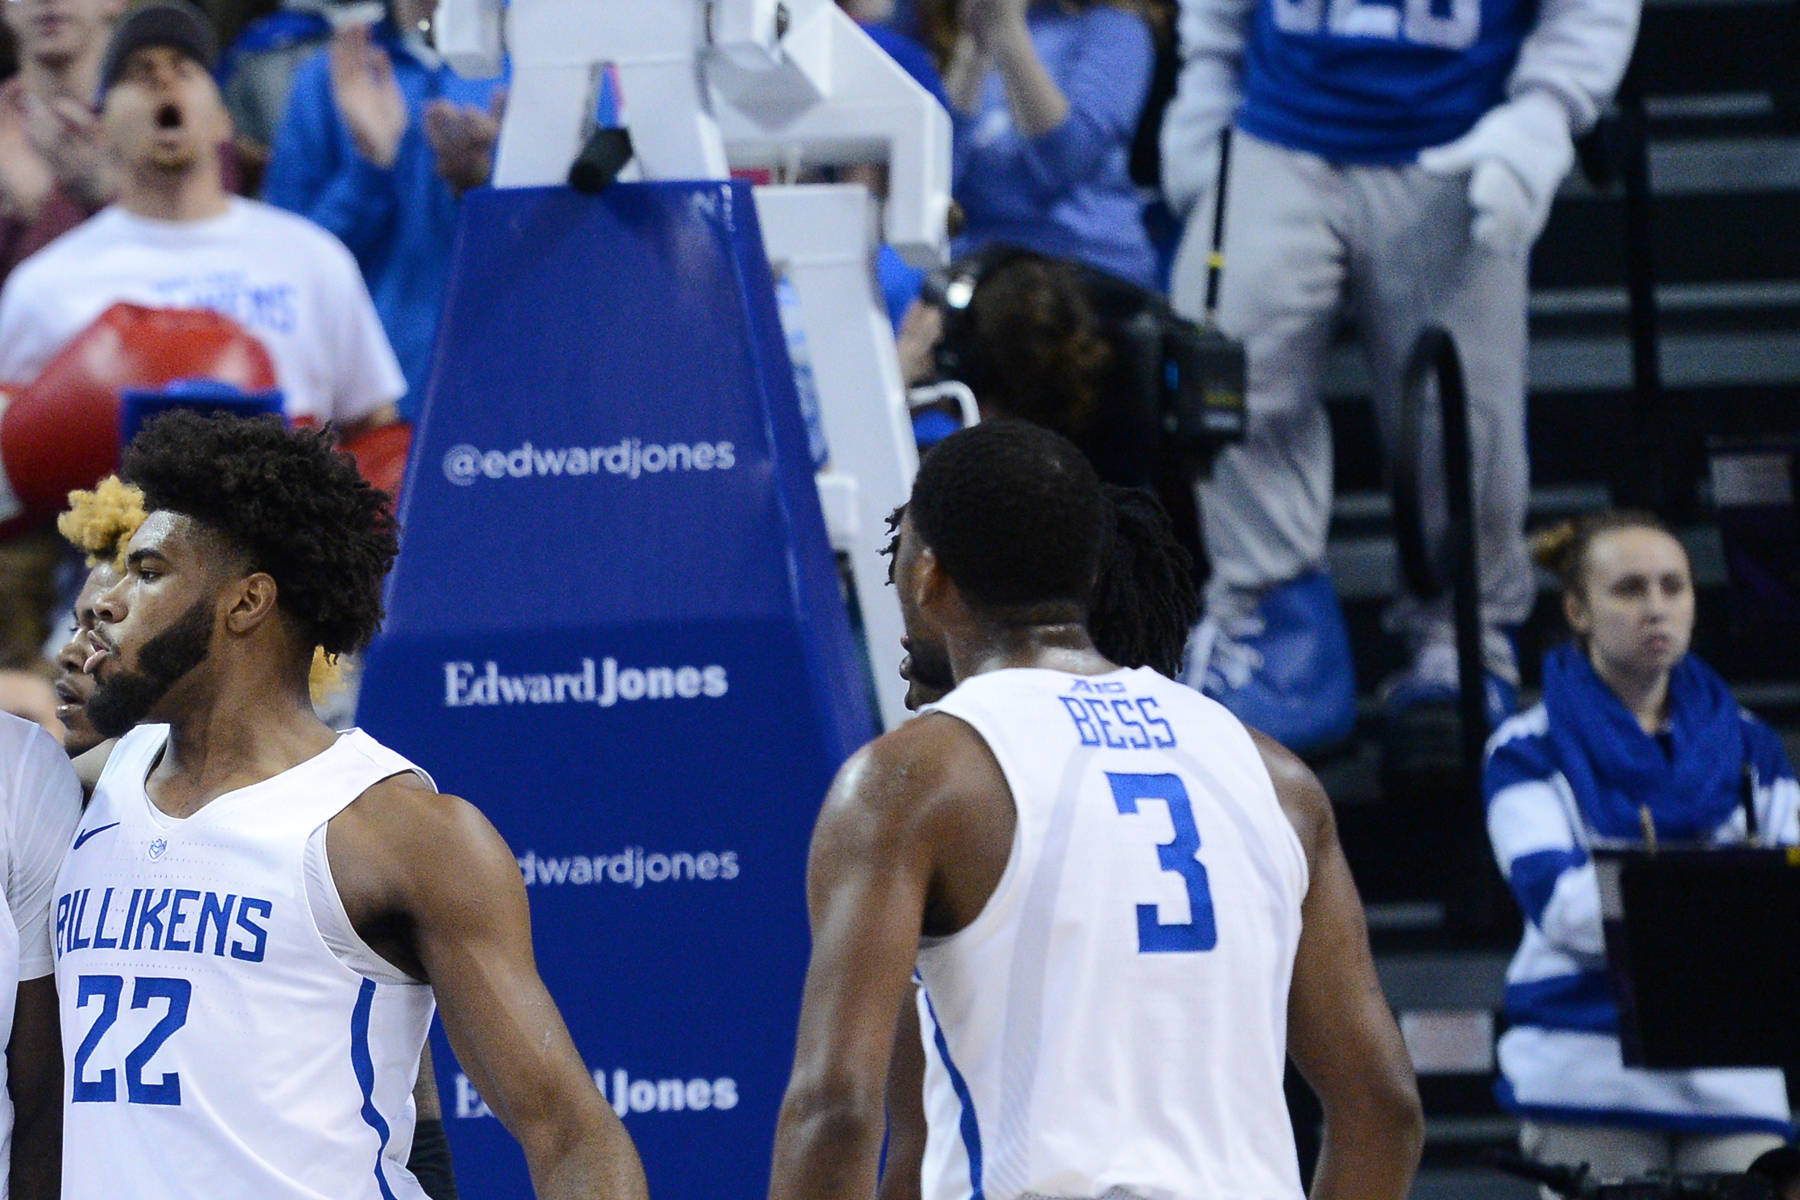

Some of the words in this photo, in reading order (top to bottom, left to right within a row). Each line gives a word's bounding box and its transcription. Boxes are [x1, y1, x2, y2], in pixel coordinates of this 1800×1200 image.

[442, 437, 736, 486] @edwardjones
[1058, 695, 1177, 749] BESS
[518, 846, 740, 889] dwardjones
[1104, 770, 1218, 954] 3
[57, 887, 273, 963] BILLIKENS
[72, 975, 192, 1106] 22
